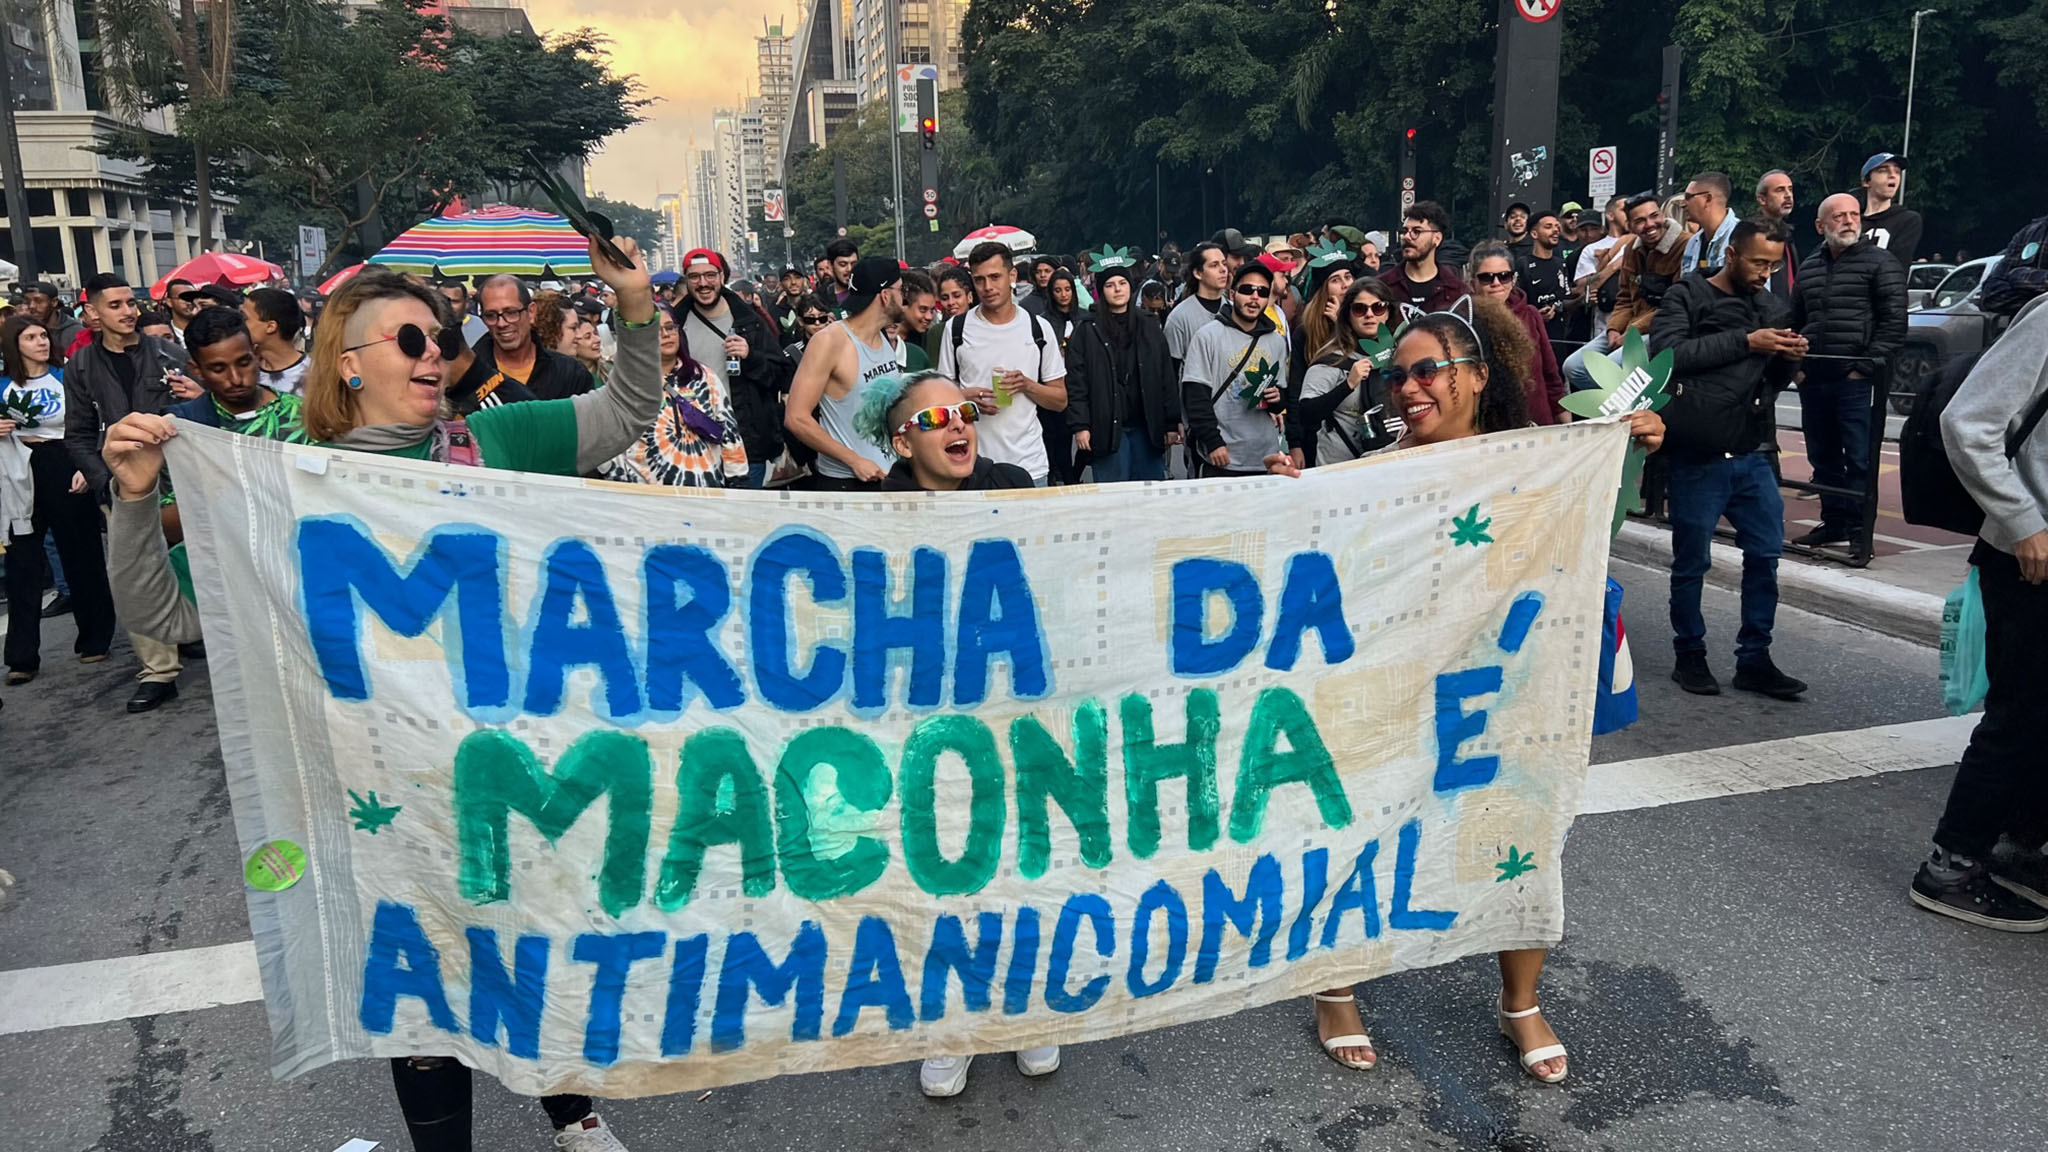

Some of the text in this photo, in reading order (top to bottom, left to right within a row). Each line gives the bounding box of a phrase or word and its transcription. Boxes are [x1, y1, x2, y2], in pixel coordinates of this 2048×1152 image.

[926, 191, 936, 199] 50
[1658, 131, 1667, 178] Paulista
[295, 513, 1356, 720] MARCHA DA
[454, 590, 1546, 919] MACONHA É
[360, 817, 1459, 1067] ANTIMANICOMIAL
